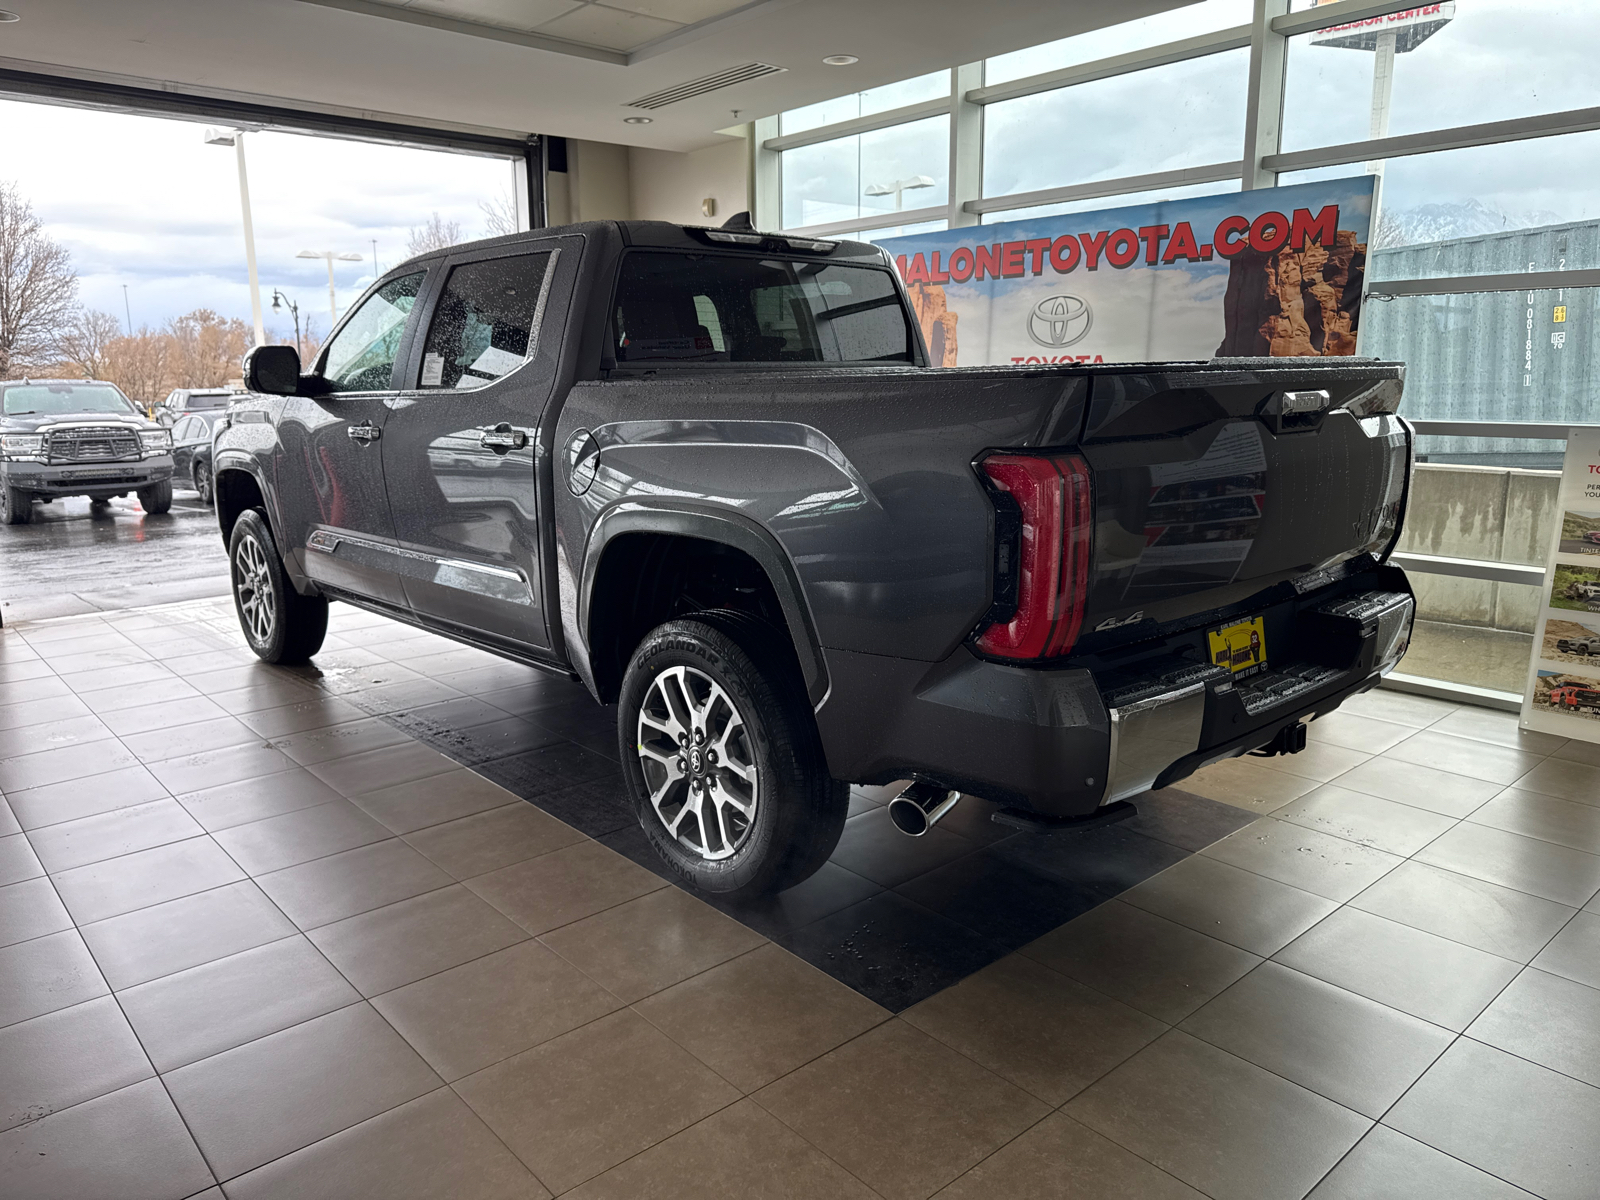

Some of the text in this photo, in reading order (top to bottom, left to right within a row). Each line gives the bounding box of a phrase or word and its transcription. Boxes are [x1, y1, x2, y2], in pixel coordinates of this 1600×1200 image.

[1527, 262, 1535, 304] EU
[1525, 308, 1534, 371] 081884
[637, 640, 720, 670] GEOLANDAR
[1251, 634, 1258, 643] 32
[650, 831, 698, 884] YOKOHAMA
